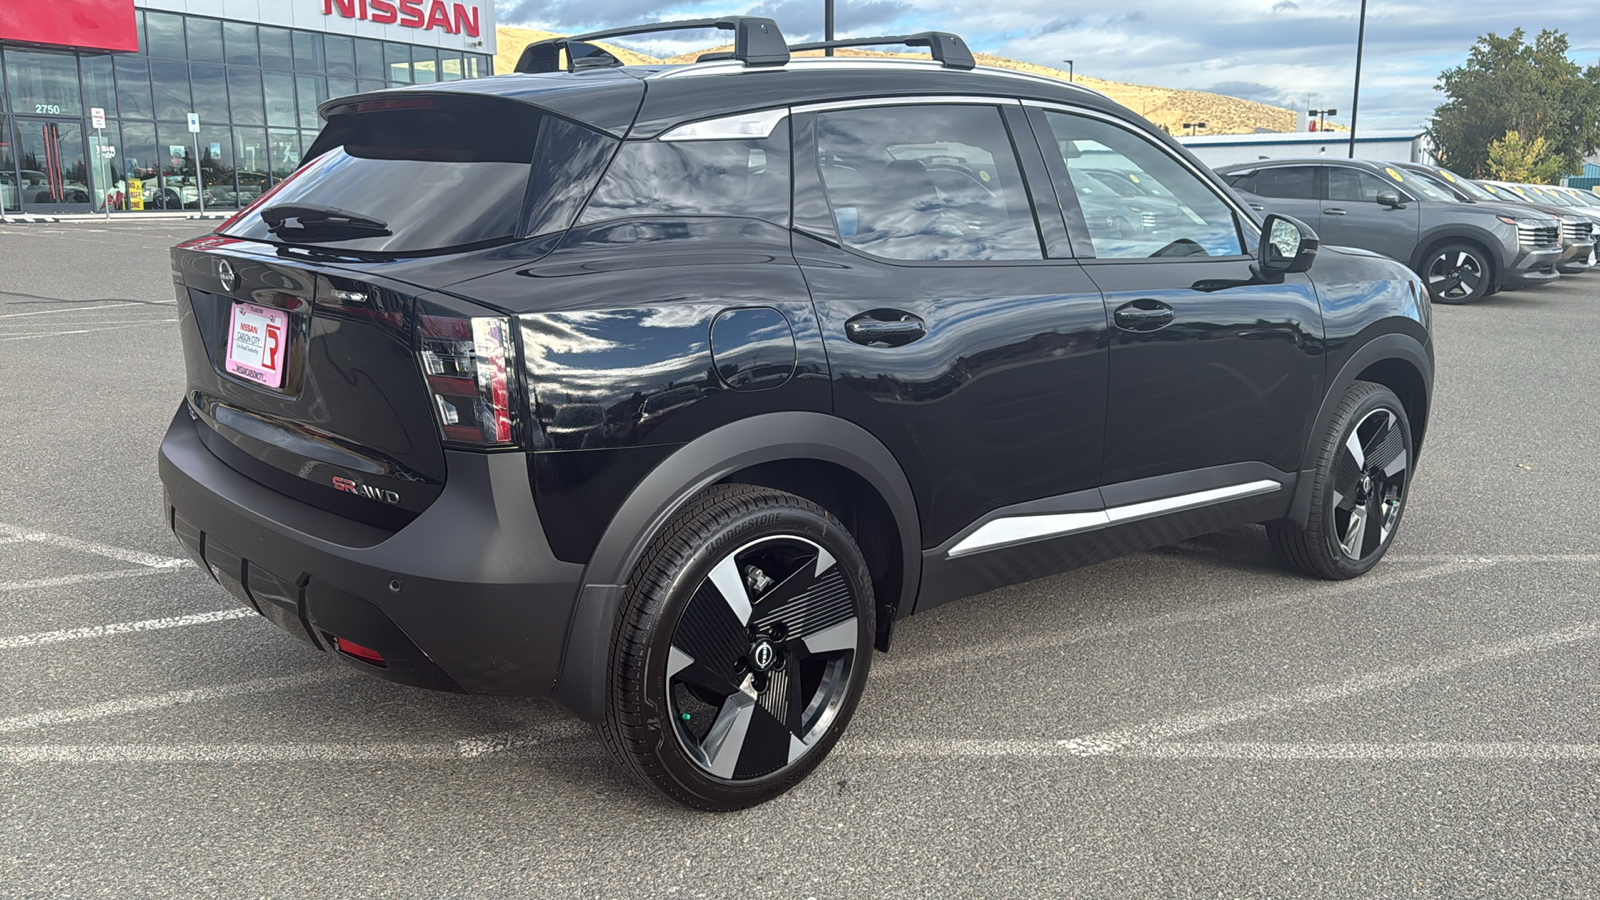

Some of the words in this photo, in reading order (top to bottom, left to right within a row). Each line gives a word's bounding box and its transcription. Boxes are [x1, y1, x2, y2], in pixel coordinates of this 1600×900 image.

[323, 0, 479, 37] NISSAN
[35, 104, 60, 115] 2750
[130, 201, 141, 209] ONE
[239, 323, 258, 334] NISSAN
[236, 332, 252, 343] CARSON
[251, 335, 261, 346] CITY
[332, 476, 358, 495] SR
[359, 484, 400, 504] AWD
[704, 512, 782, 558] BRIDGESTONE
